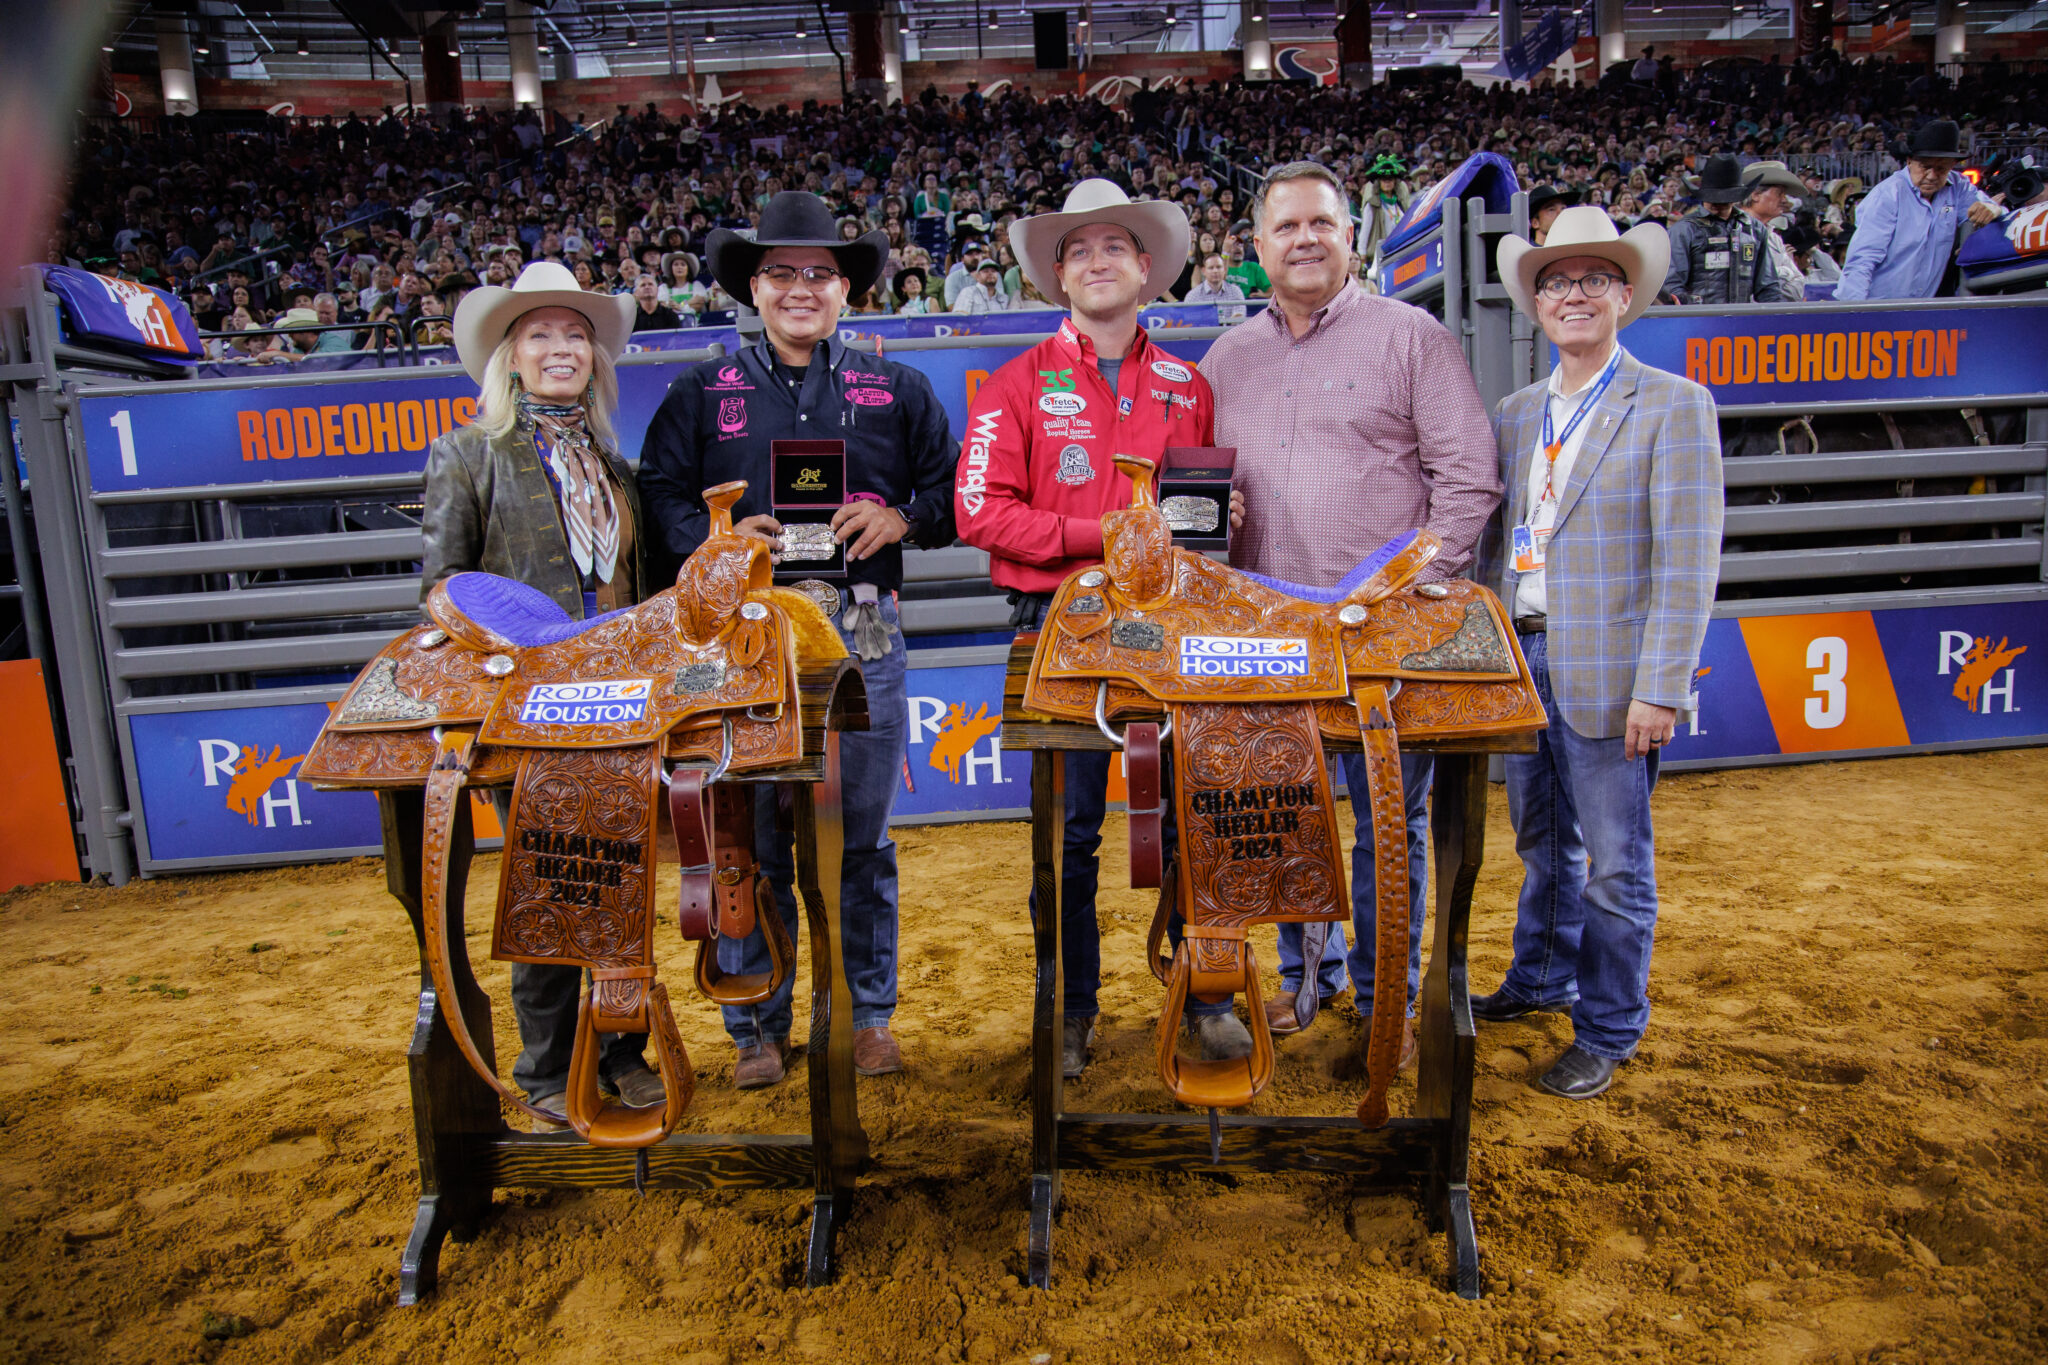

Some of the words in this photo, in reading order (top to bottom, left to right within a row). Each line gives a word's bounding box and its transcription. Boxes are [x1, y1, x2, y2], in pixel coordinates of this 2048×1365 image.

[1043, 417, 1070, 430] Quality
[1070, 416, 1092, 427] Team
[110, 410, 138, 476] 1
[1185, 639, 1303, 655] RODEO
[532, 682, 646, 700] RODEO
[1804, 636, 1848, 729] 3
[1192, 784, 1314, 815] CHAMPION
[1213, 811, 1298, 838] HEELER
[522, 830, 642, 864] CHAMPION
[1232, 837, 1282, 860] 2024
[535, 857, 622, 886] HEADER
[550, 881, 601, 907] 2024
